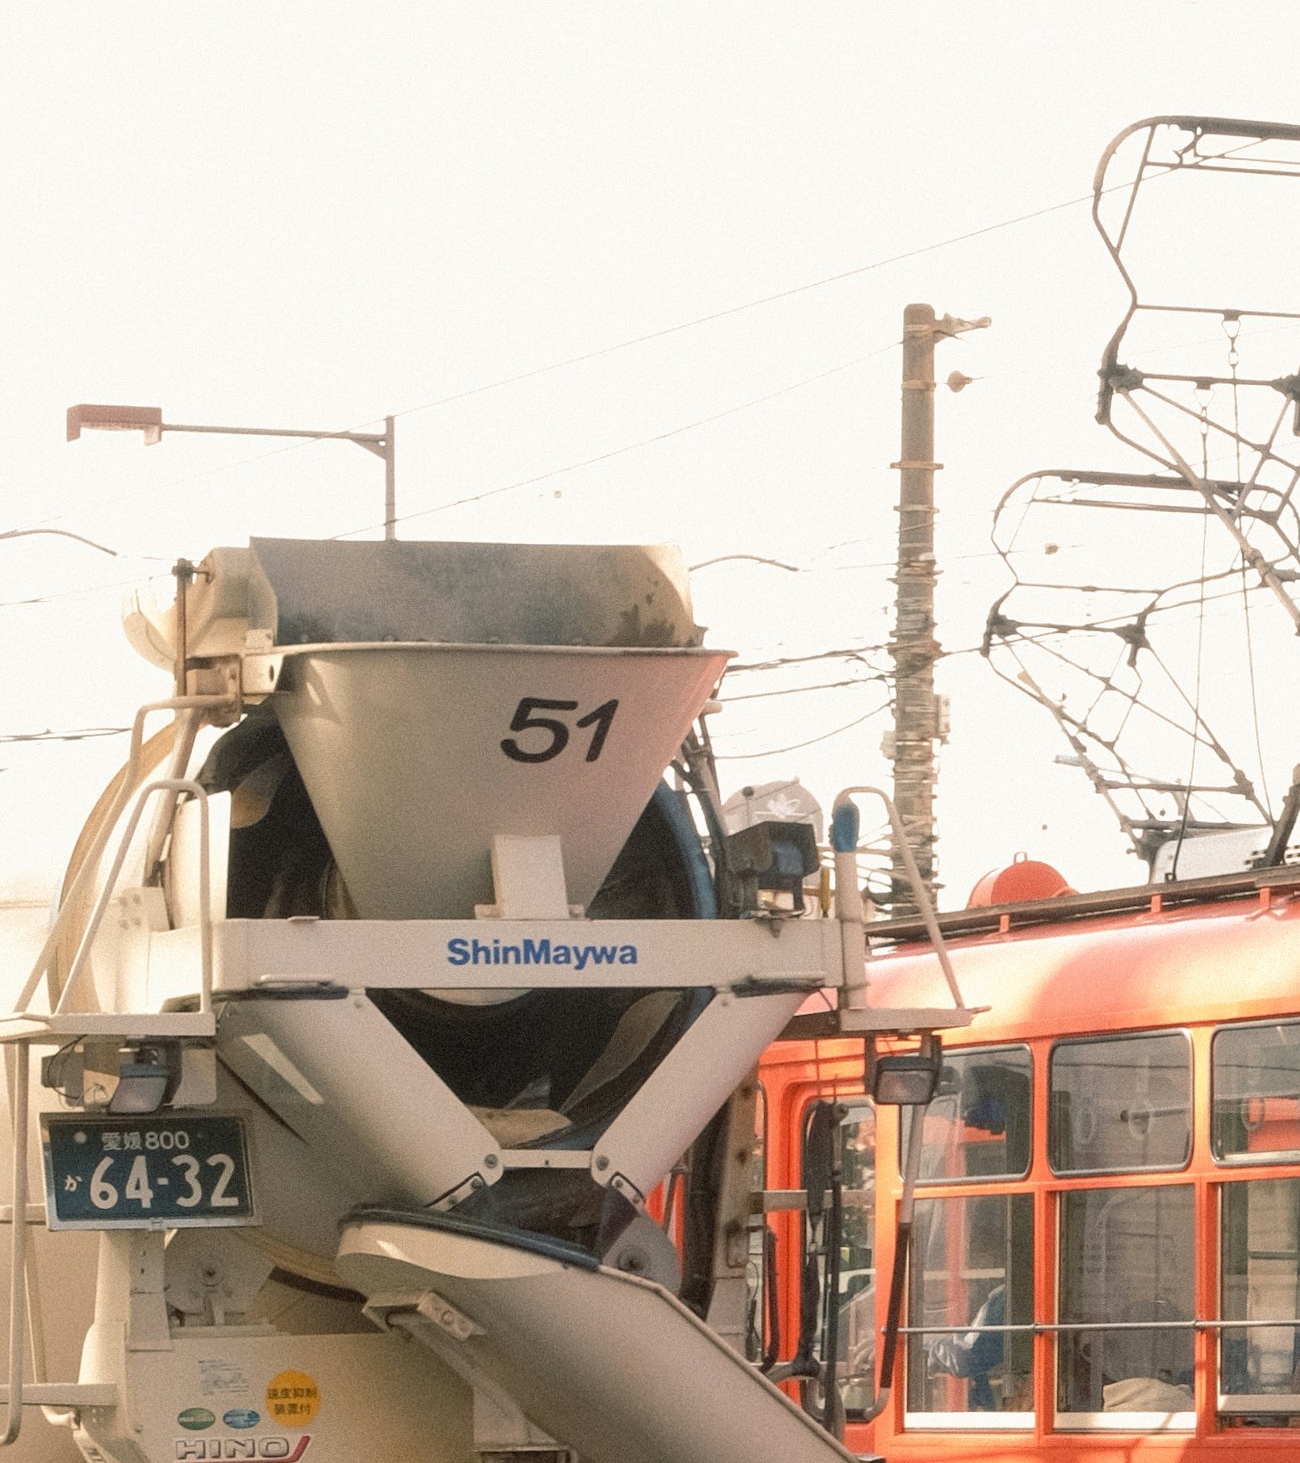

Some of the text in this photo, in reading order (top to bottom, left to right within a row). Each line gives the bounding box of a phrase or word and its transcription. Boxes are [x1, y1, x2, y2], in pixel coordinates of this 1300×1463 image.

[500, 696, 620, 764] 51
[447, 938, 638, 970] ShinMaywa
[90, 1153, 240, 1210] 64-32
[176, 1437, 290, 1459] HINO
